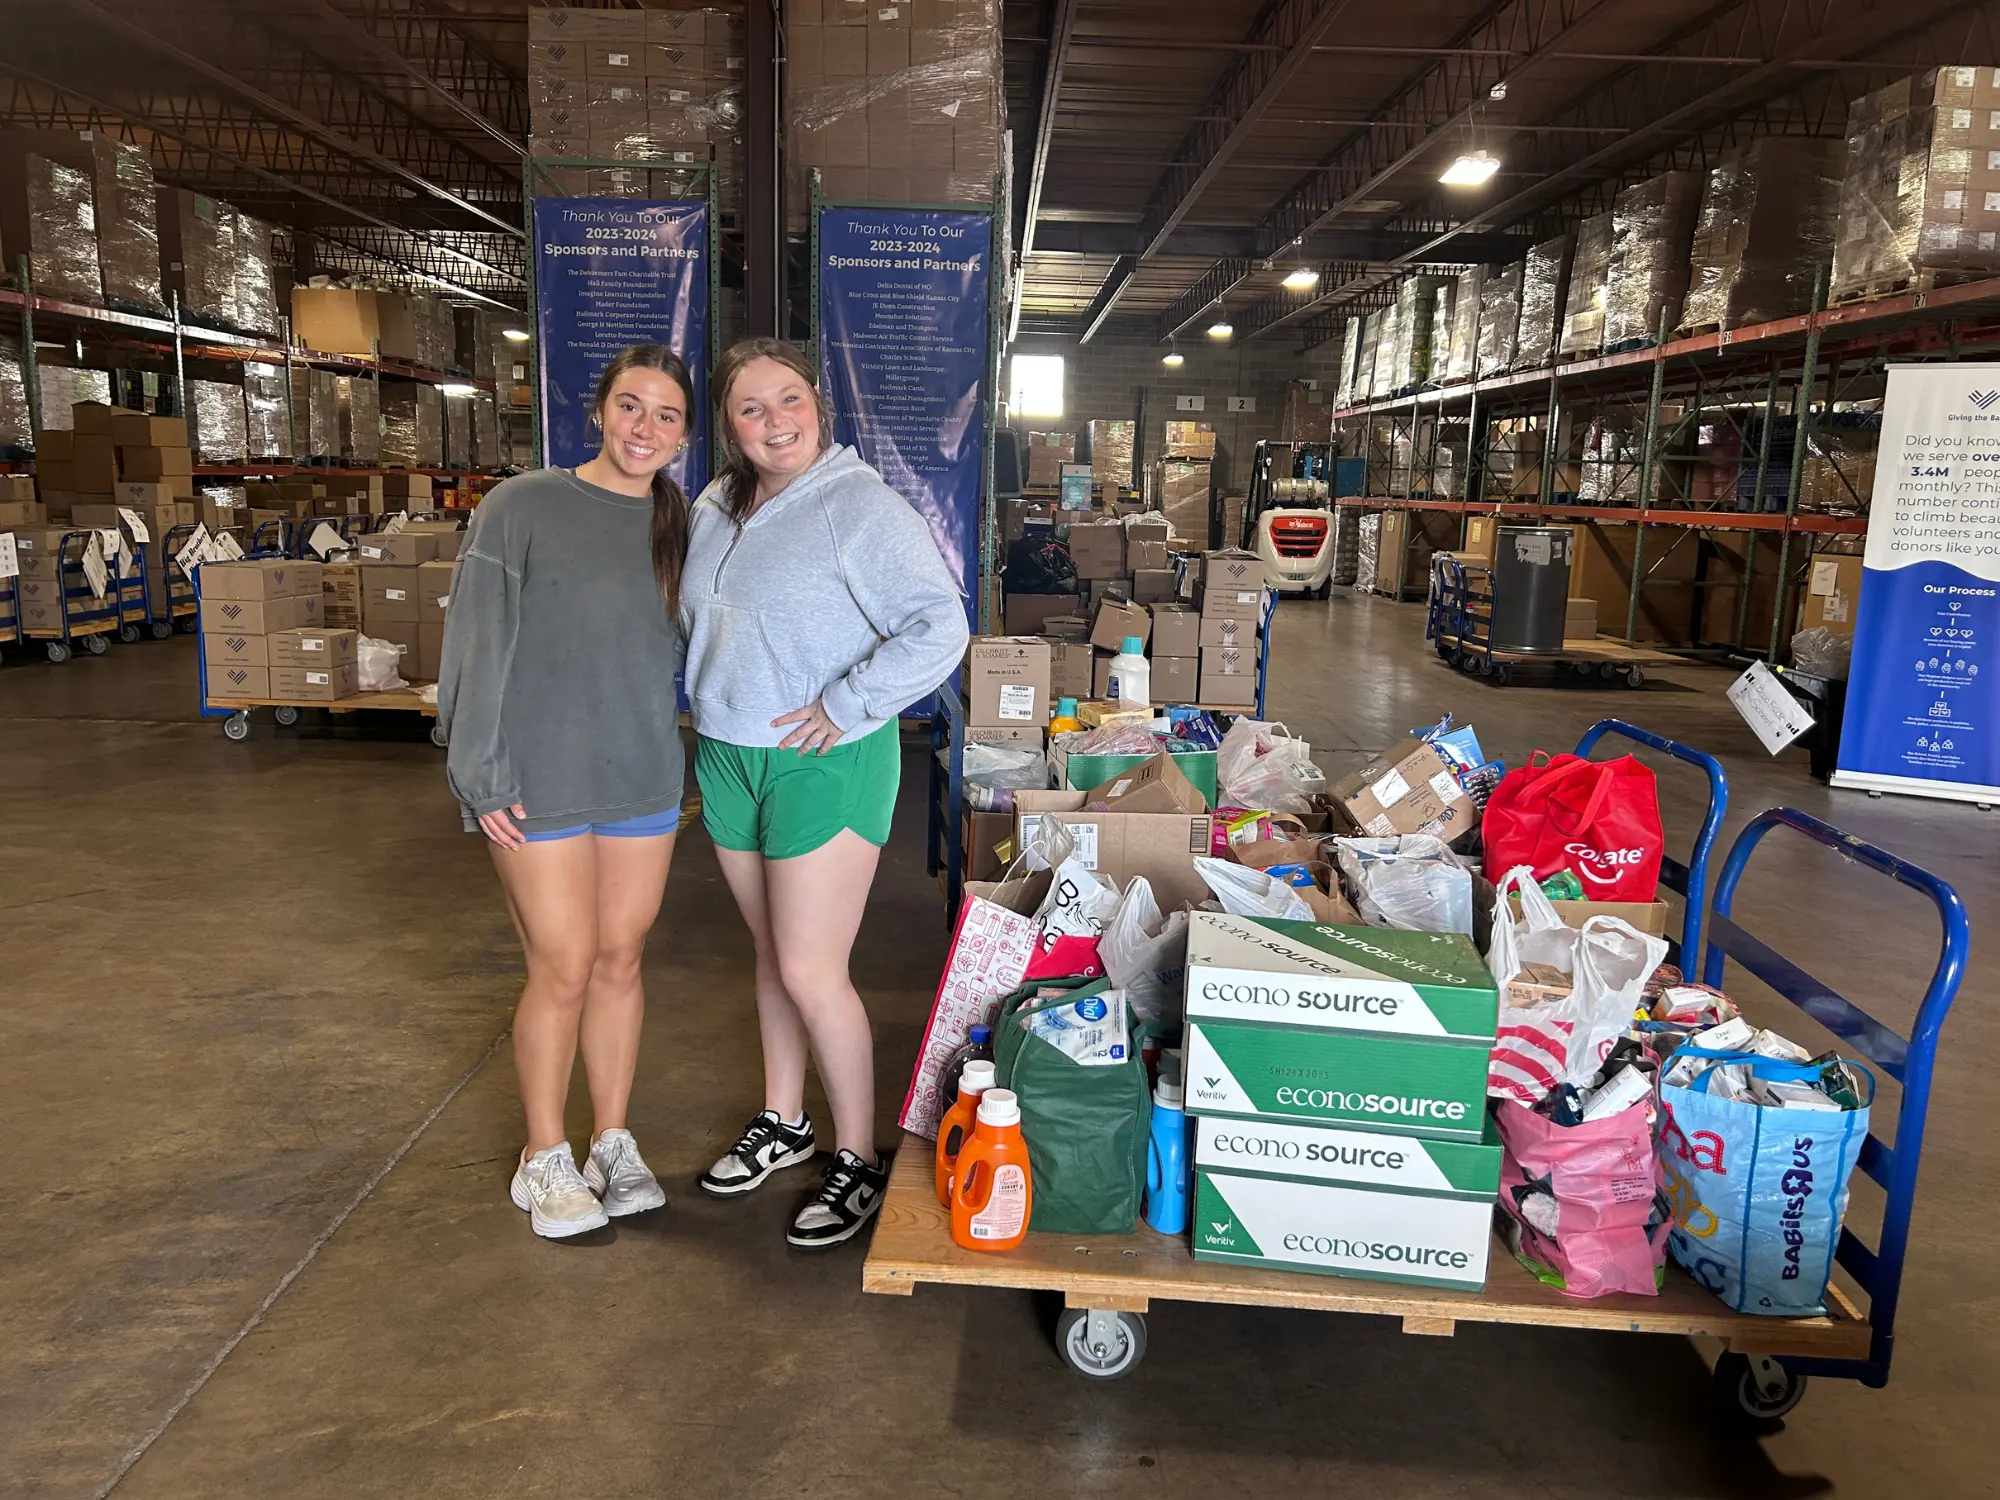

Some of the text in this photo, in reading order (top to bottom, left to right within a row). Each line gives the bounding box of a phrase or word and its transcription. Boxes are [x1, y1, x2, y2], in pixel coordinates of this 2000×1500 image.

[562, 210, 681, 225] Thank You To Our
[586, 228, 658, 241] 2023-2024
[848, 222, 965, 238] Thank You To Our
[544, 244, 699, 259] Sponsors and Partners
[870, 240, 941, 254] 2023-2024
[829, 255, 981, 272] Sponsors and Partners
[604, 291, 631, 299] Learning
[908, 324, 938, 332] Thompson
[831, 341, 864, 349] Mechanical
[914, 365, 945, 373] Landscape
[1188, 398, 1193, 408] 1
[1239, 400, 1245, 410] 2
[1948, 414, 1972, 422] Giving
[1906, 435, 1931, 446] Did
[1934, 437, 1962, 448] you
[1903, 453, 2000, 462] we serve ove
[1911, 466, 2000, 479] 3.4M peop
[1899, 482, 1972, 494] monthly?
[1897, 497, 2000, 509] number conti
[1895, 512, 1909, 521] to
[1913, 512, 1956, 522] climb
[1893, 526, 1970, 538] volunteers
[179, 555, 192, 568] Big
[188, 531, 207, 556] Brothers
[1891, 541, 1942, 552] donors
[1946, 542, 1972, 554] like
[1924, 585, 1996, 596] Our Process
[1750, 698, 1774, 727] School
[1564, 843, 1642, 869] Colgate
[1199, 915, 1341, 975] econo source
[1316, 926, 1467, 984] econosource
[1203, 982, 1398, 1016] econo source
[1084, 998, 1098, 1020] Dial
[1715, 1030, 1730, 1040] Dove
[1196, 1089, 1227, 1101] Veritiv
[1276, 1086, 1465, 1120] econosource
[1214, 1133, 1404, 1170] econo source
[1205, 1234, 1235, 1246] Veritiv
[1283, 1233, 1468, 1269] econosource
